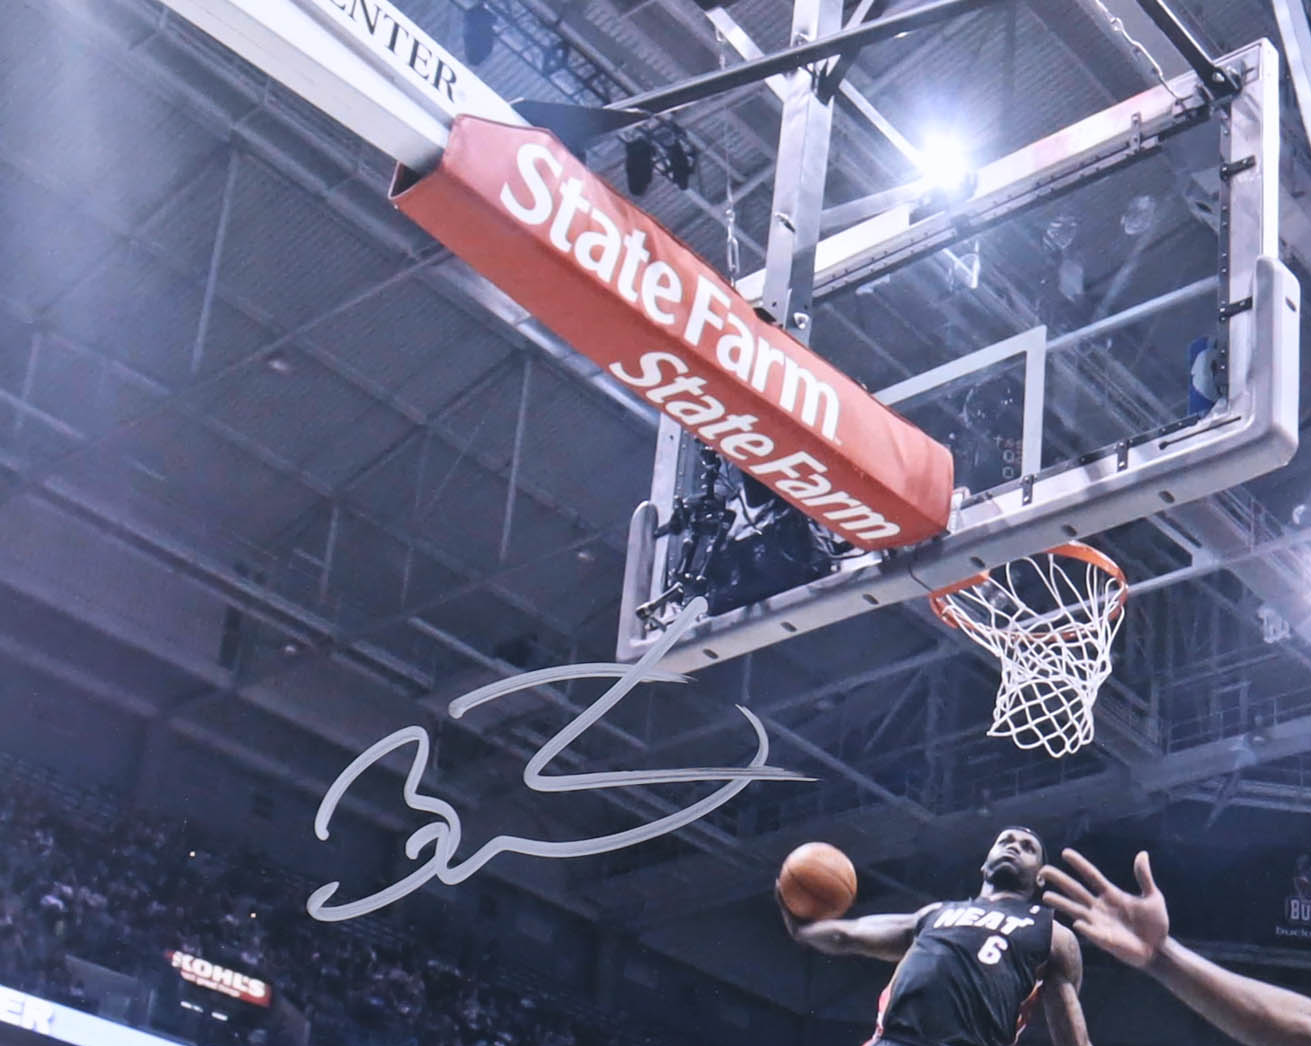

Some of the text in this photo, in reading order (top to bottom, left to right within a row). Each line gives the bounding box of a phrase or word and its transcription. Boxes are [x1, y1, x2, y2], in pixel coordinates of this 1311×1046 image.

[500, 143, 846, 446] State Farm
[609, 351, 902, 541] State Farm
[933, 906, 1035, 935] HEAT
[977, 935, 1009, 965] 6
